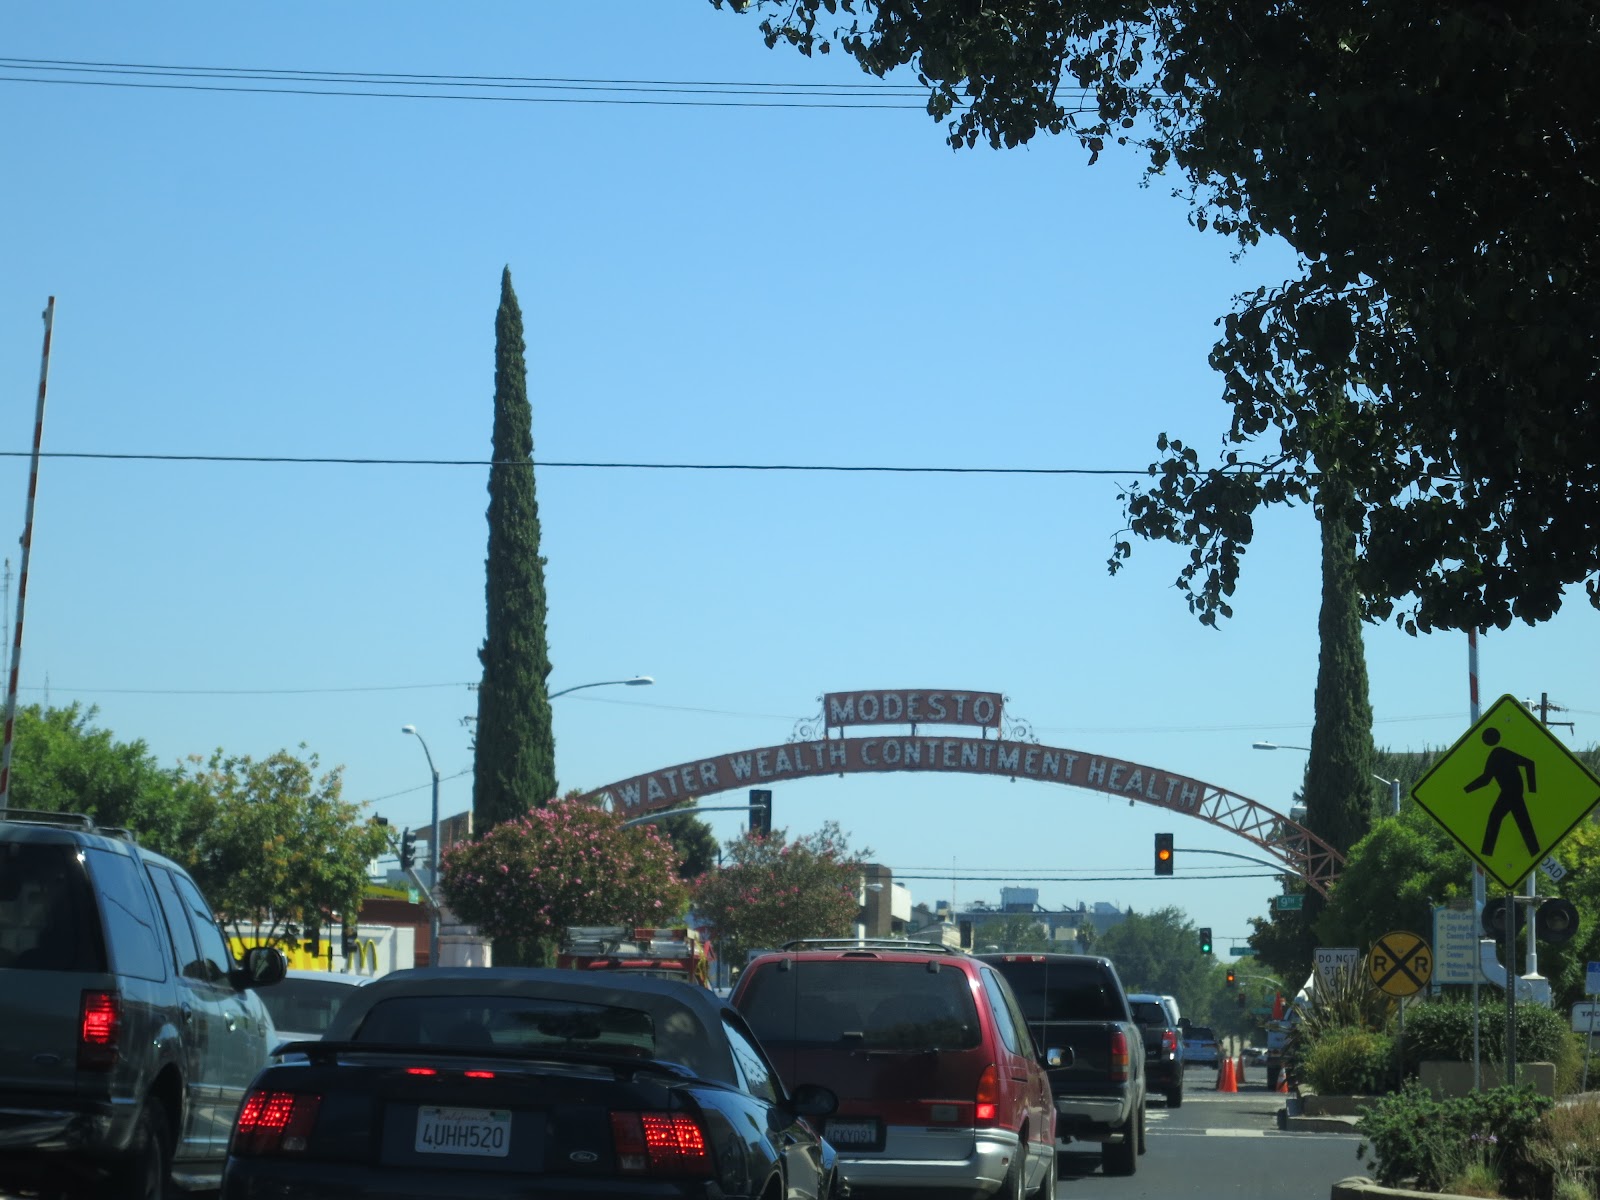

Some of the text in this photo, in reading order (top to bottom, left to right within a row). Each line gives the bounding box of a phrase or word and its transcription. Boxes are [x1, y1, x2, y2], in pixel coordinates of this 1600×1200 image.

[830, 693, 995, 724] MODESTO
[617, 739, 1199, 809] WATER WEALTH CONTENTMENT HEALTH
[1319, 955, 1332, 963] DO
[422, 1118, 504, 1149] 4UHH520
